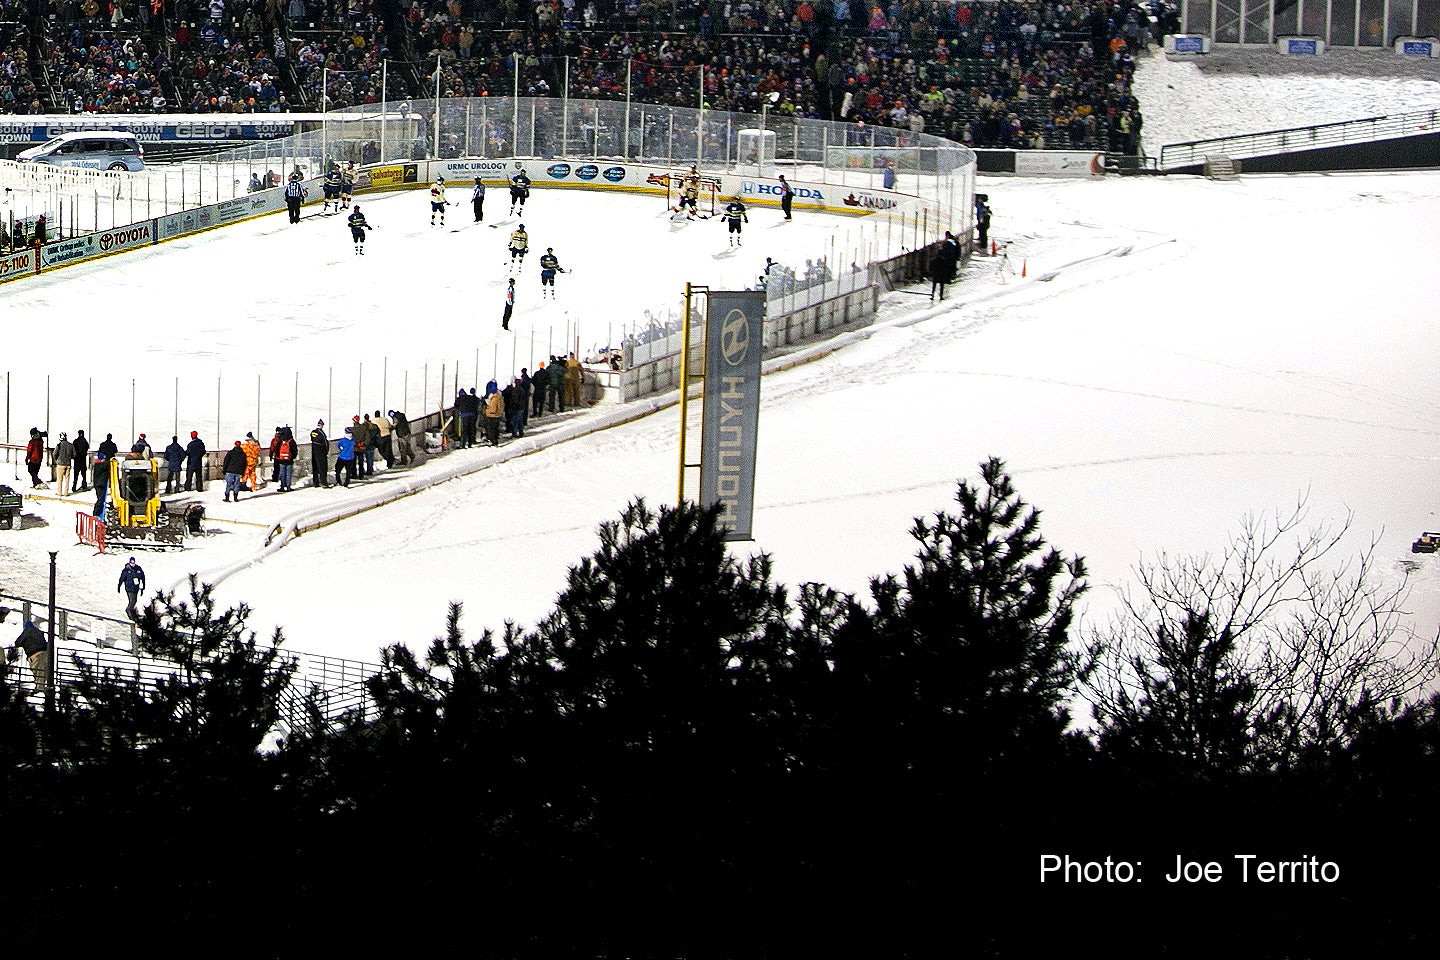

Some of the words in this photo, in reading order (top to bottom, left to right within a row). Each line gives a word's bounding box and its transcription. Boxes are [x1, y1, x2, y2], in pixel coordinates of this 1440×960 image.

[126, 125, 163, 133] SOUTH
[175, 125, 242, 138] GEICO
[255, 124, 292, 133] SOUTH
[0, 134, 31, 142] TOWN
[133, 133, 161, 141] OWN
[471, 162, 508, 170] UROLOGY
[372, 169, 403, 180] salvatores
[113, 226, 150, 245] TOYOTA
[715, 376, 746, 532] HYUNDAI
